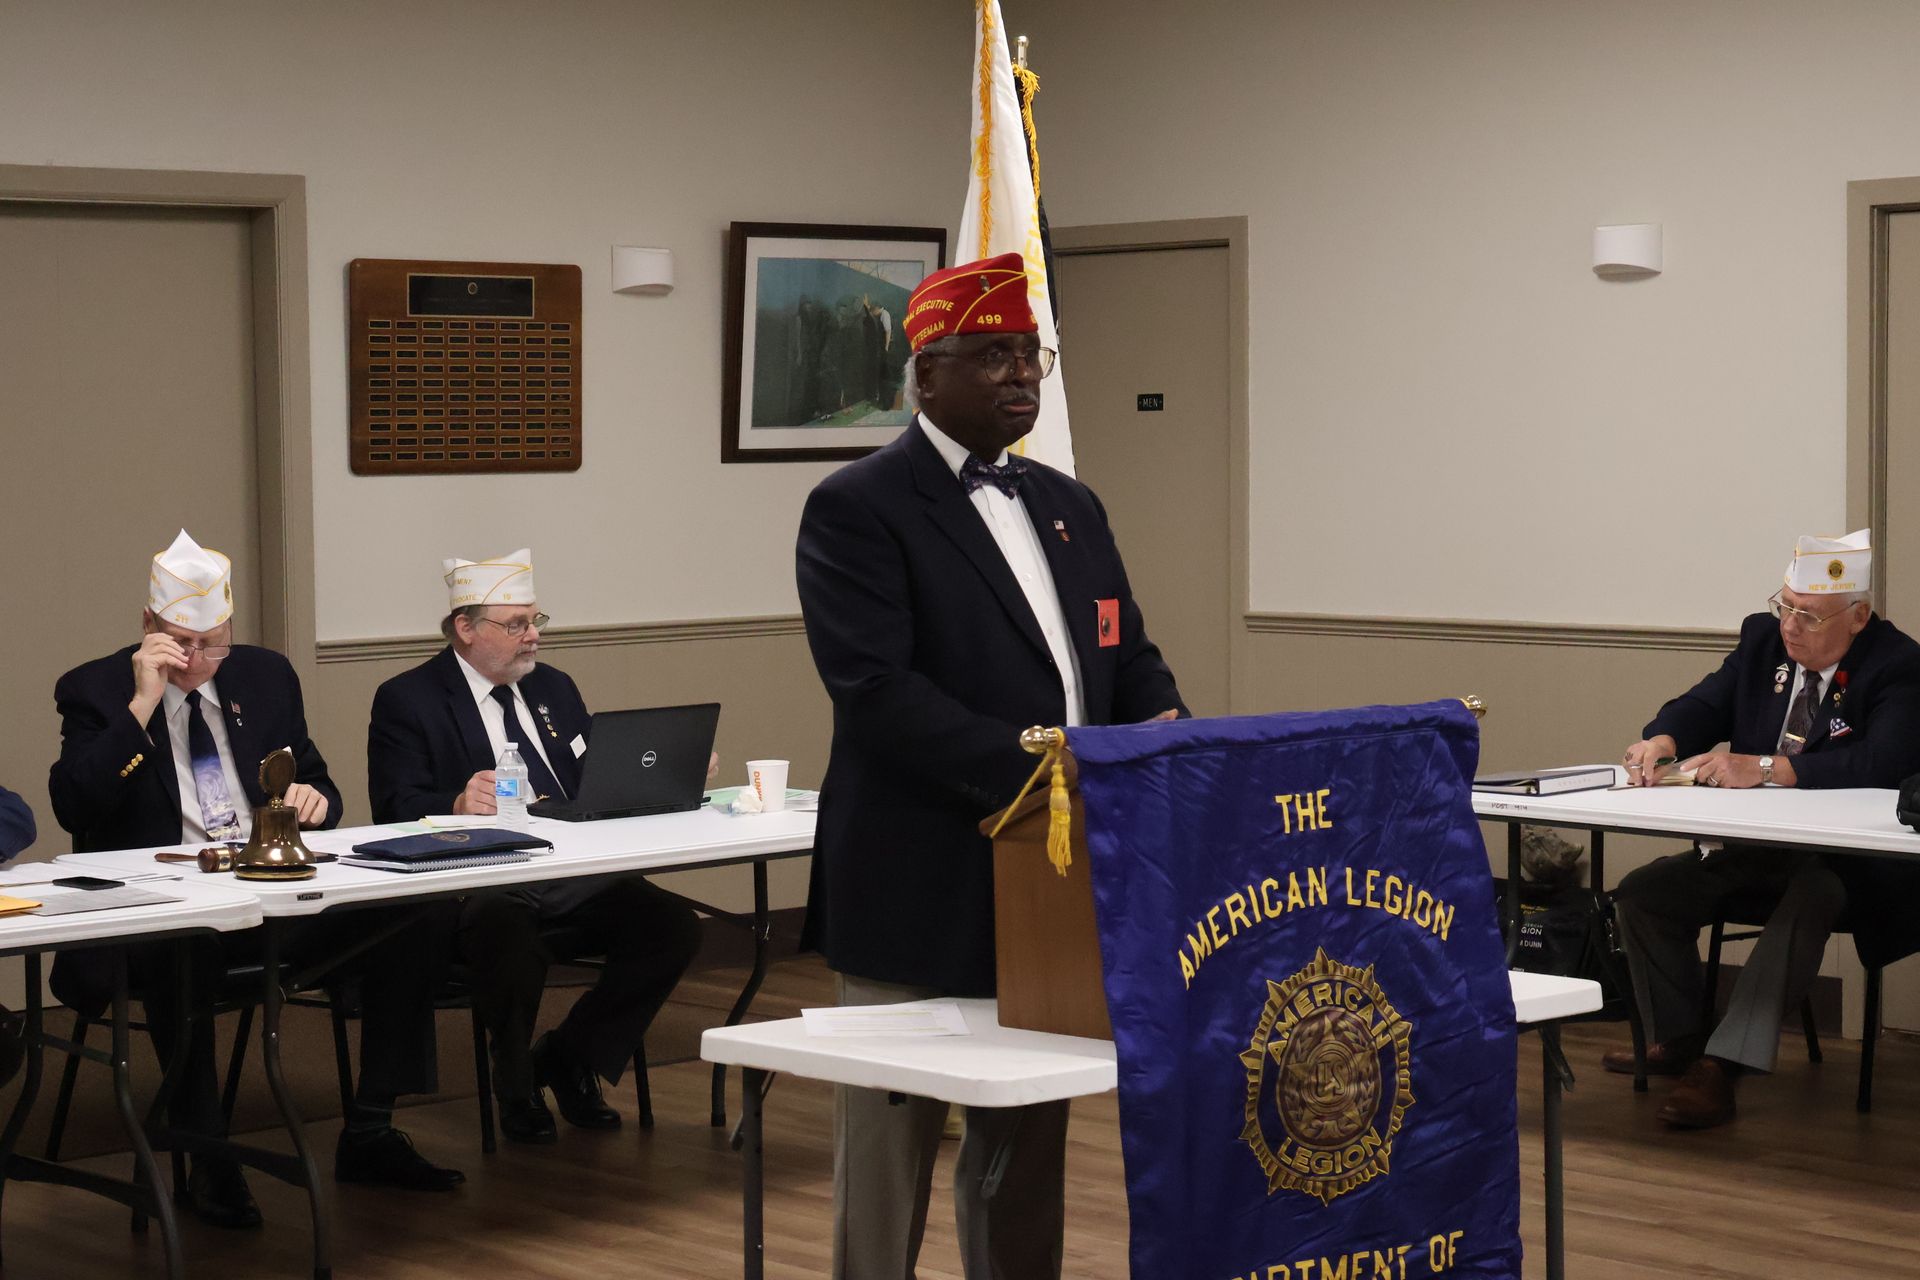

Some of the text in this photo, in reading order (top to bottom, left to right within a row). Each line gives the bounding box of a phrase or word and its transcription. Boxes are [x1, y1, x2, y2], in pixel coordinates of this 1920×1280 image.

[915, 299, 955, 316] EXECUTIVE
[976, 314, 1003, 325] 499
[911, 320, 945, 349] TTEEMAN
[1142, 397, 1158, 408] MEN
[1275, 788, 1333, 834] THE
[1177, 866, 1456, 990] AMERICAN LEGION
[1520, 926, 1543, 936] GION
[1524, 940, 1543, 949] DUNN
[1267, 982, 1393, 1066] AMERICAN
[1277, 1127, 1383, 1175] LEGION
[1428, 1230, 1464, 1273] OF
